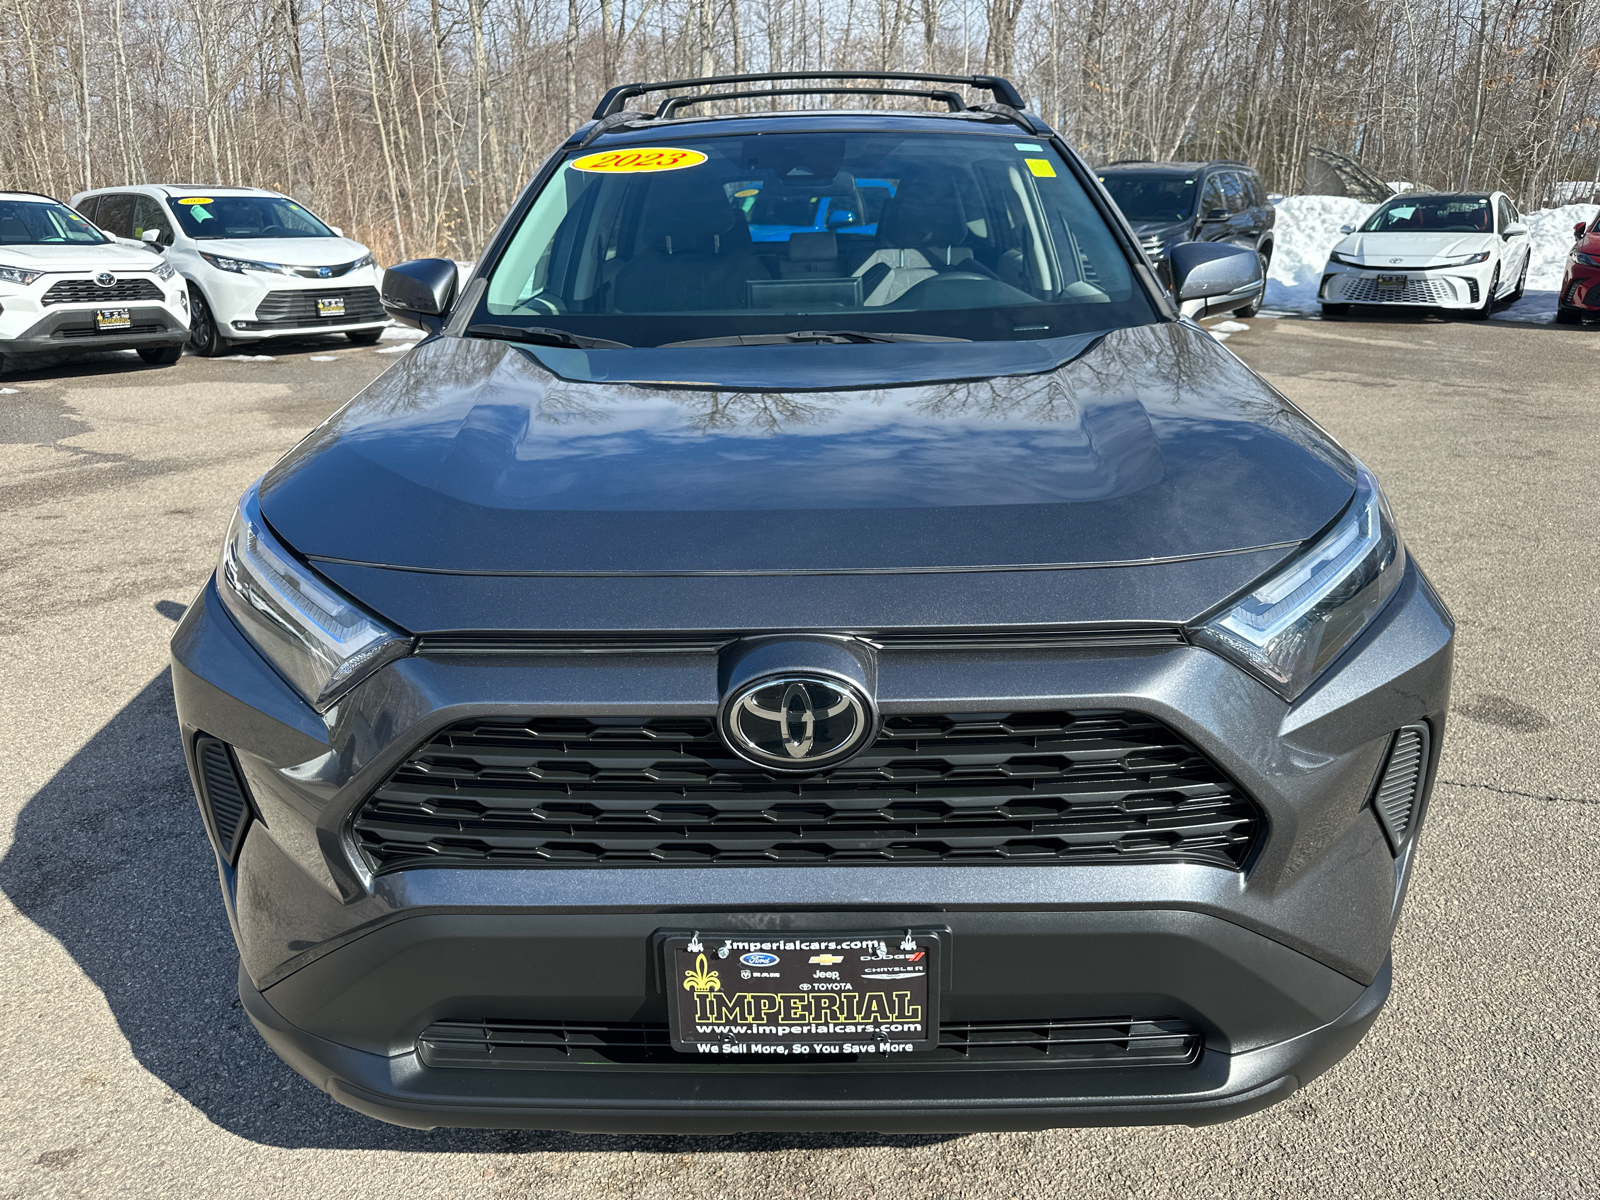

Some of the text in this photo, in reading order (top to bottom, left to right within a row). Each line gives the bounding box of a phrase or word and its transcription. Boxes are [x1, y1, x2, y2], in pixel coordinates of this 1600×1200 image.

[589, 153, 687, 168] 2023
[725, 939, 879, 952] Imperialcars.com
[748, 954, 771, 964] Ford
[860, 953, 916, 961] DODGE
[813, 970, 839, 979] Jeep
[813, 983, 853, 991] TOYOTA
[694, 991, 922, 1024] IMPERIAL
[696, 1023, 922, 1036] www.imperialcars.com
[697, 1042, 914, 1055] We Sell More, So You Save More
